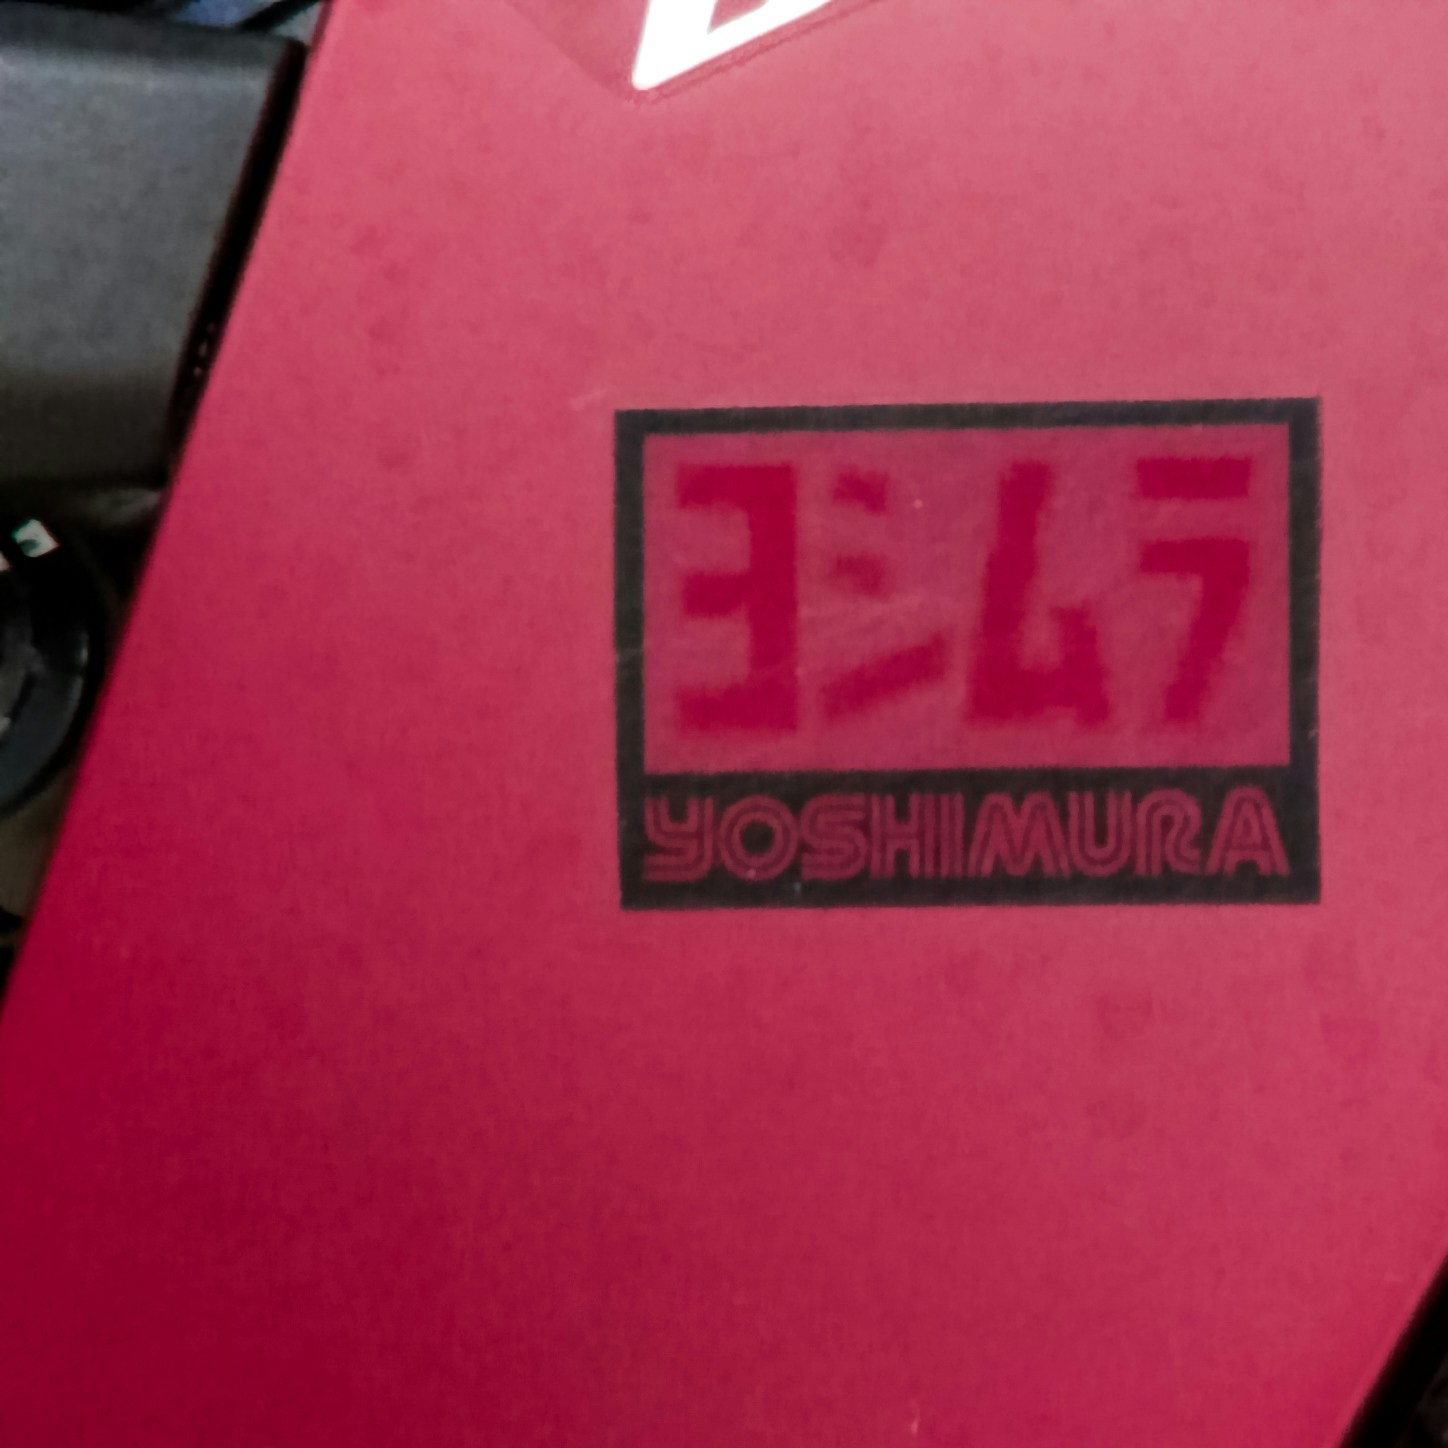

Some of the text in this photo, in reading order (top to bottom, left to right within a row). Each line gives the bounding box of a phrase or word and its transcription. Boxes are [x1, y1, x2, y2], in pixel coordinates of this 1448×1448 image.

[671, 455, 1256, 738] ヨシムラ
[641, 786, 1290, 884] YOSHIMURA
